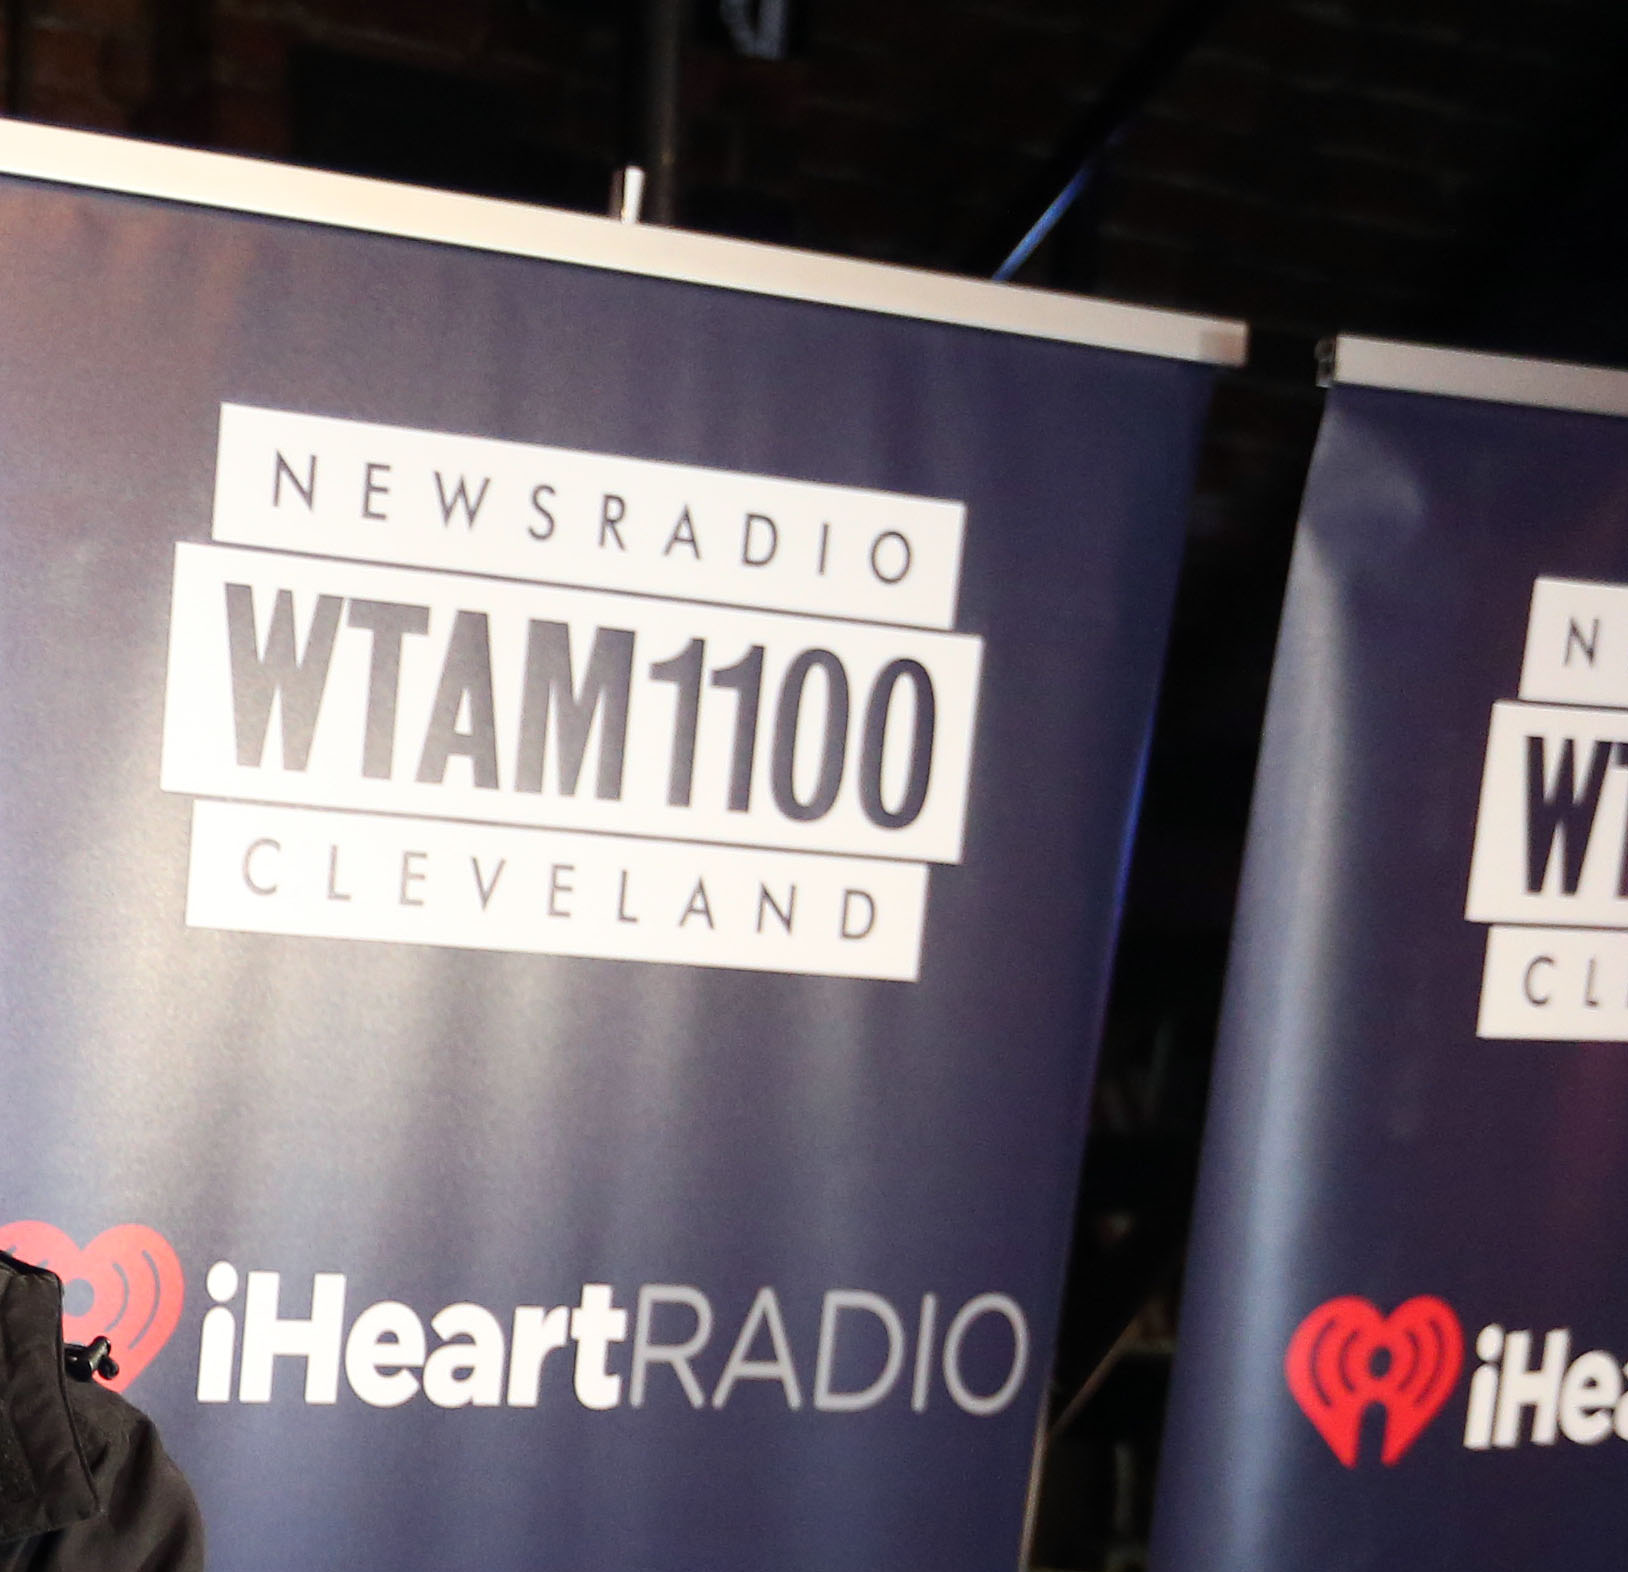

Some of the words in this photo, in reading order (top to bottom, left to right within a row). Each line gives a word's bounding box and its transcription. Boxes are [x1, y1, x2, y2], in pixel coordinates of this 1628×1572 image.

[272, 450, 913, 587] NEWSRADIO
[224, 580, 936, 831] WTAM1100
[241, 837, 877, 942] CLEVELAND
[196, 1260, 1030, 1416] iHeartRADIO
